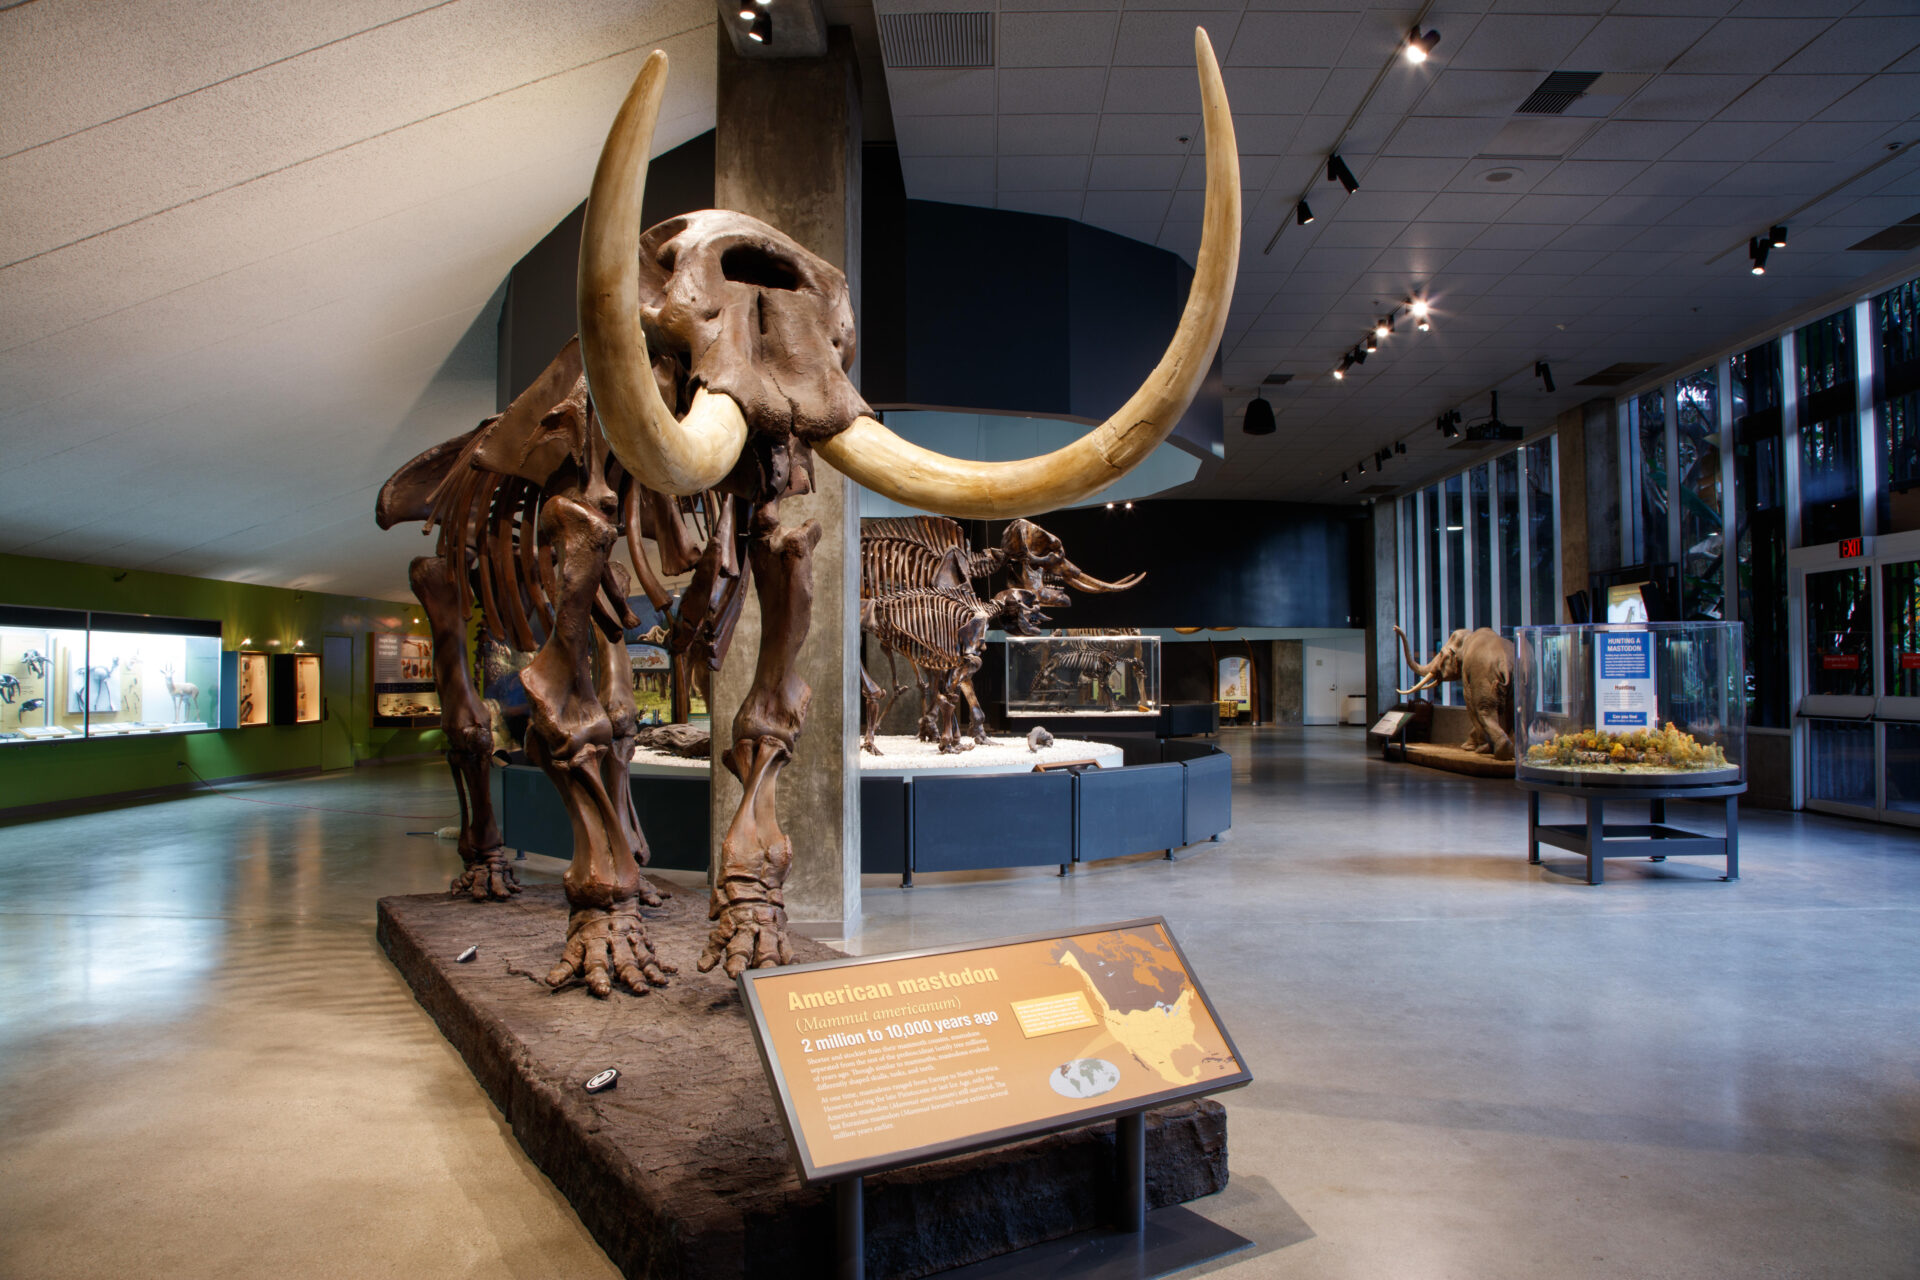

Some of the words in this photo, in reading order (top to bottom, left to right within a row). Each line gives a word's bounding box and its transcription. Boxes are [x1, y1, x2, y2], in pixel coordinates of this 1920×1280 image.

[1843, 538, 1860, 558] EXIT
[788, 983, 891, 1011] American
[897, 967, 998, 994] mastodon
[796, 1012, 868, 1033] (Mammut
[872, 996, 960, 1020] americanum)
[802, 1038, 812, 1053] 2
[816, 1032, 864, 1051] million
[868, 1028, 882, 1042] to
[886, 1020, 932, 1040] 10,000
[935, 1014, 972, 1034] years
[973, 1011, 999, 1025] ago
